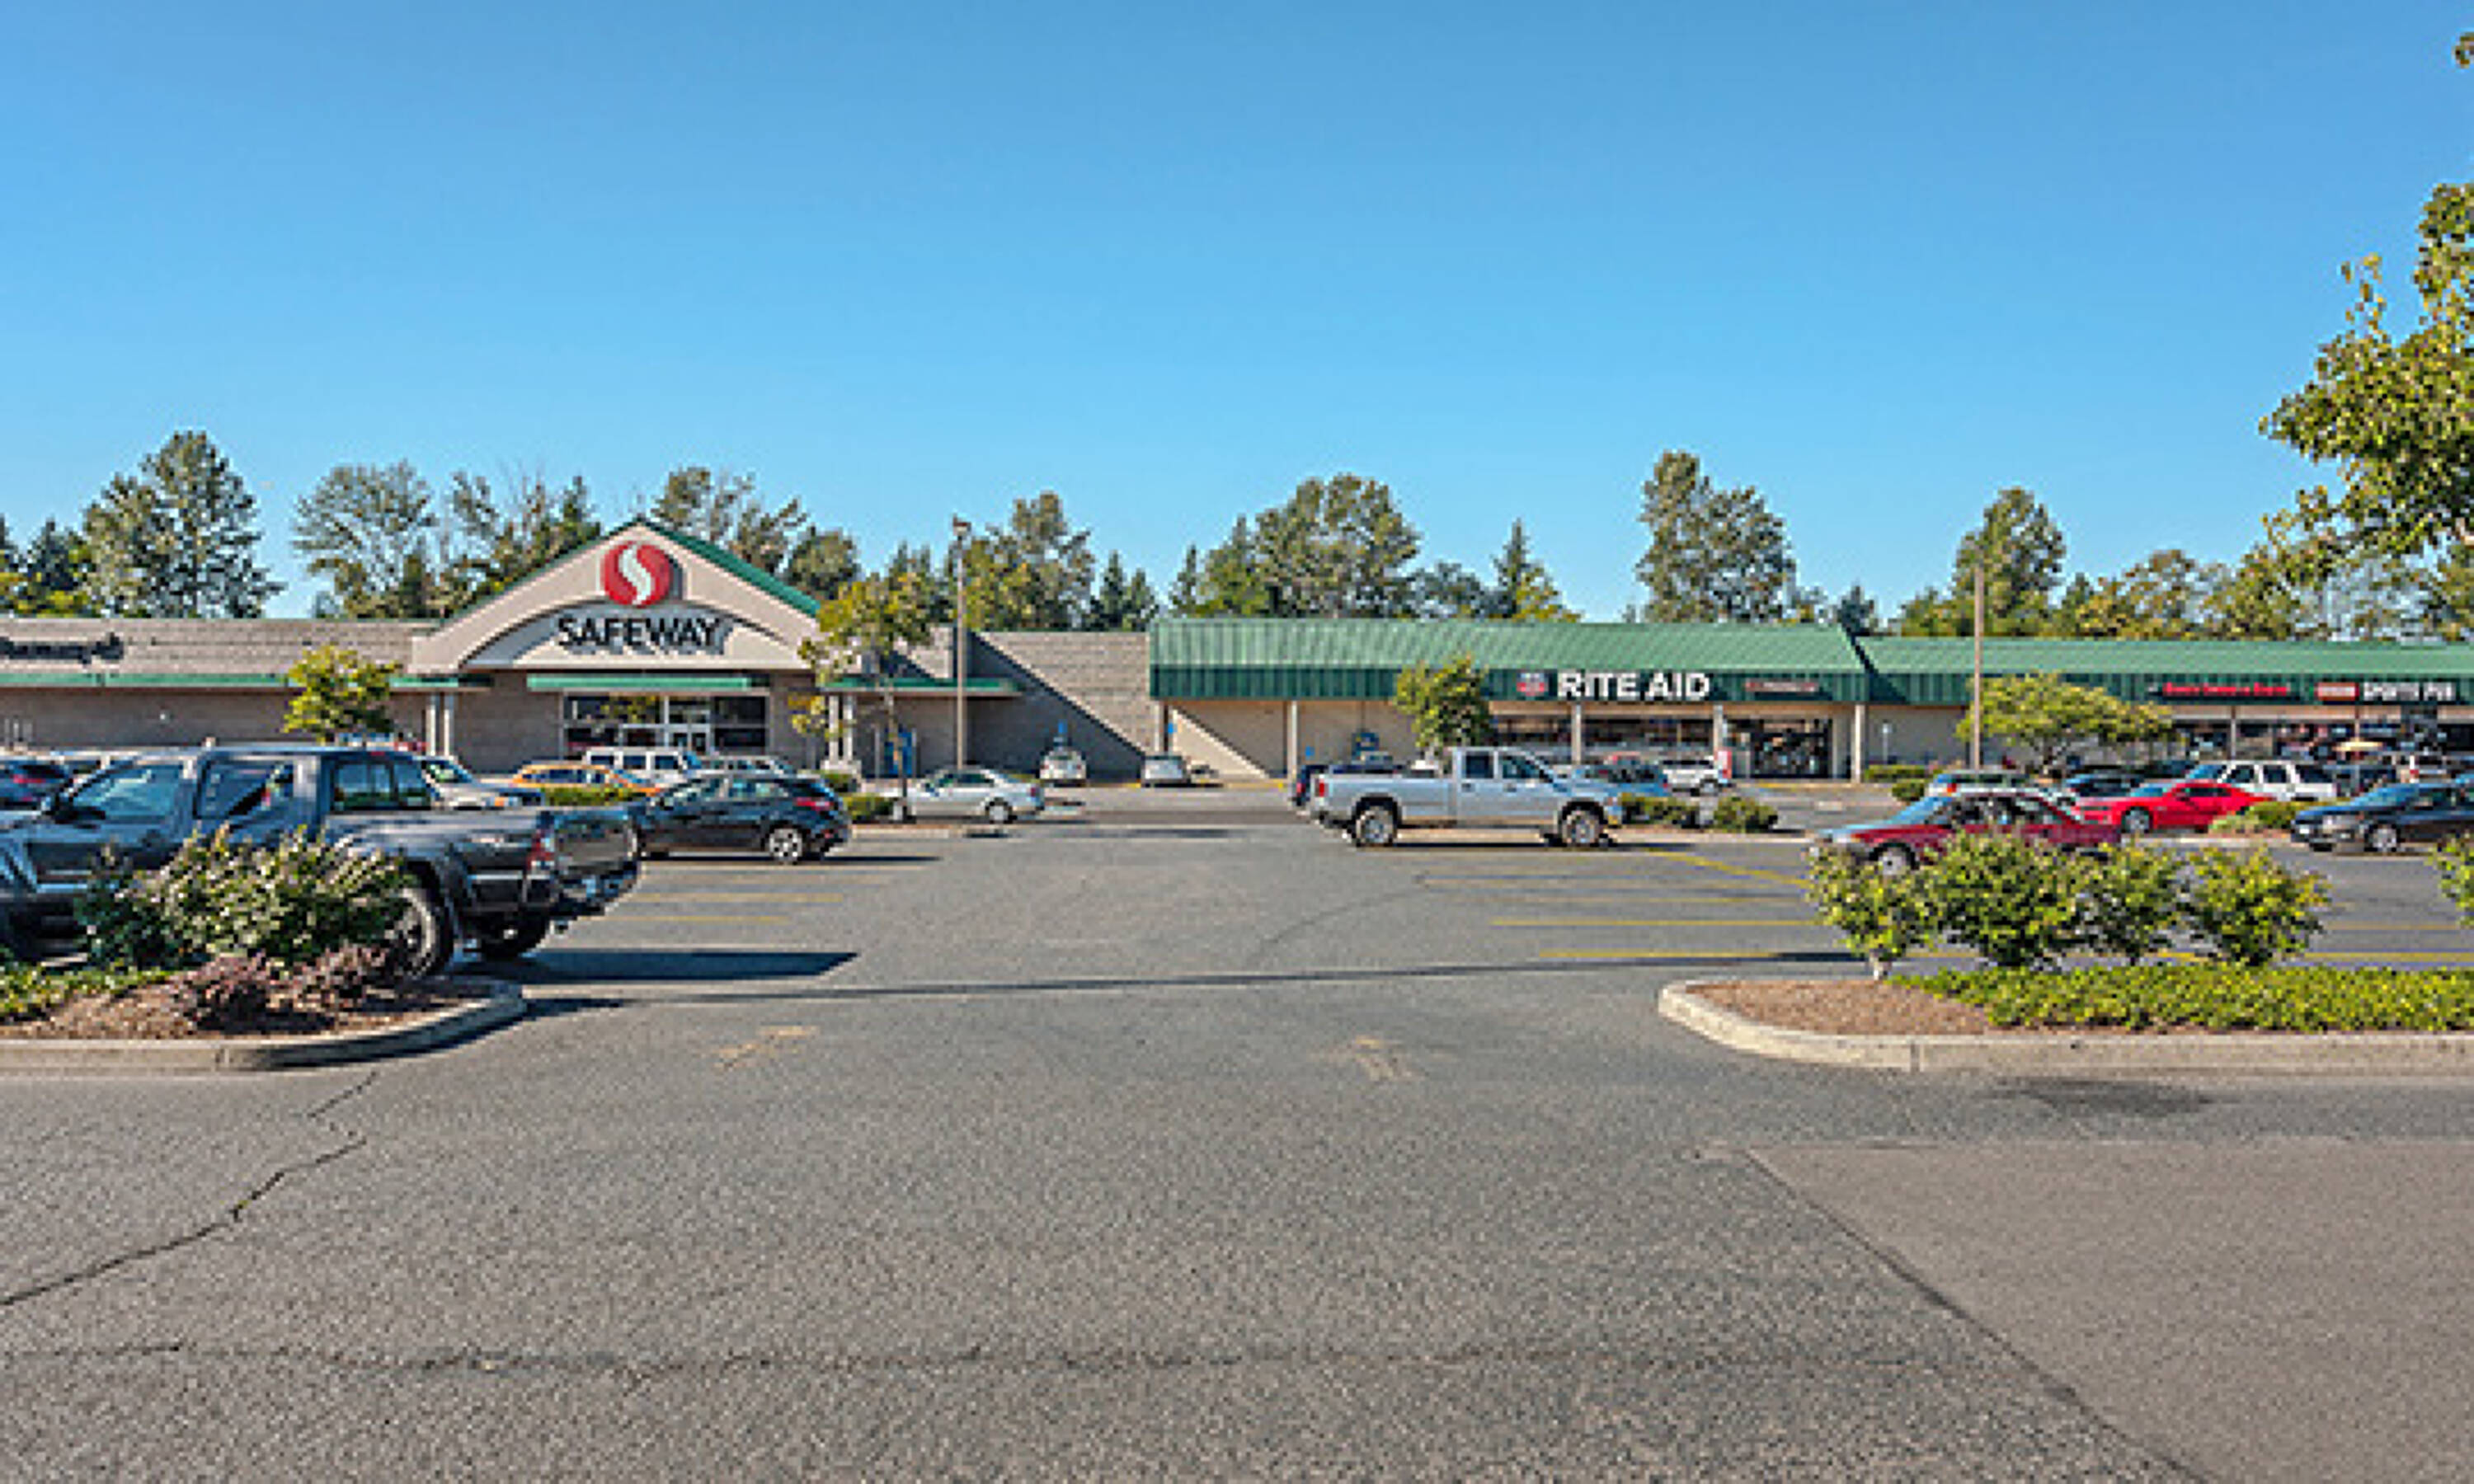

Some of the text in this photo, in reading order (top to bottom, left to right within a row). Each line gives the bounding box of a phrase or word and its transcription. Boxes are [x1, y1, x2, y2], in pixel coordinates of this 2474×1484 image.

[557, 617, 720, 646] SAFEWAY
[1557, 671, 1637, 698] RITE
[1644, 671, 1711, 698] AID
